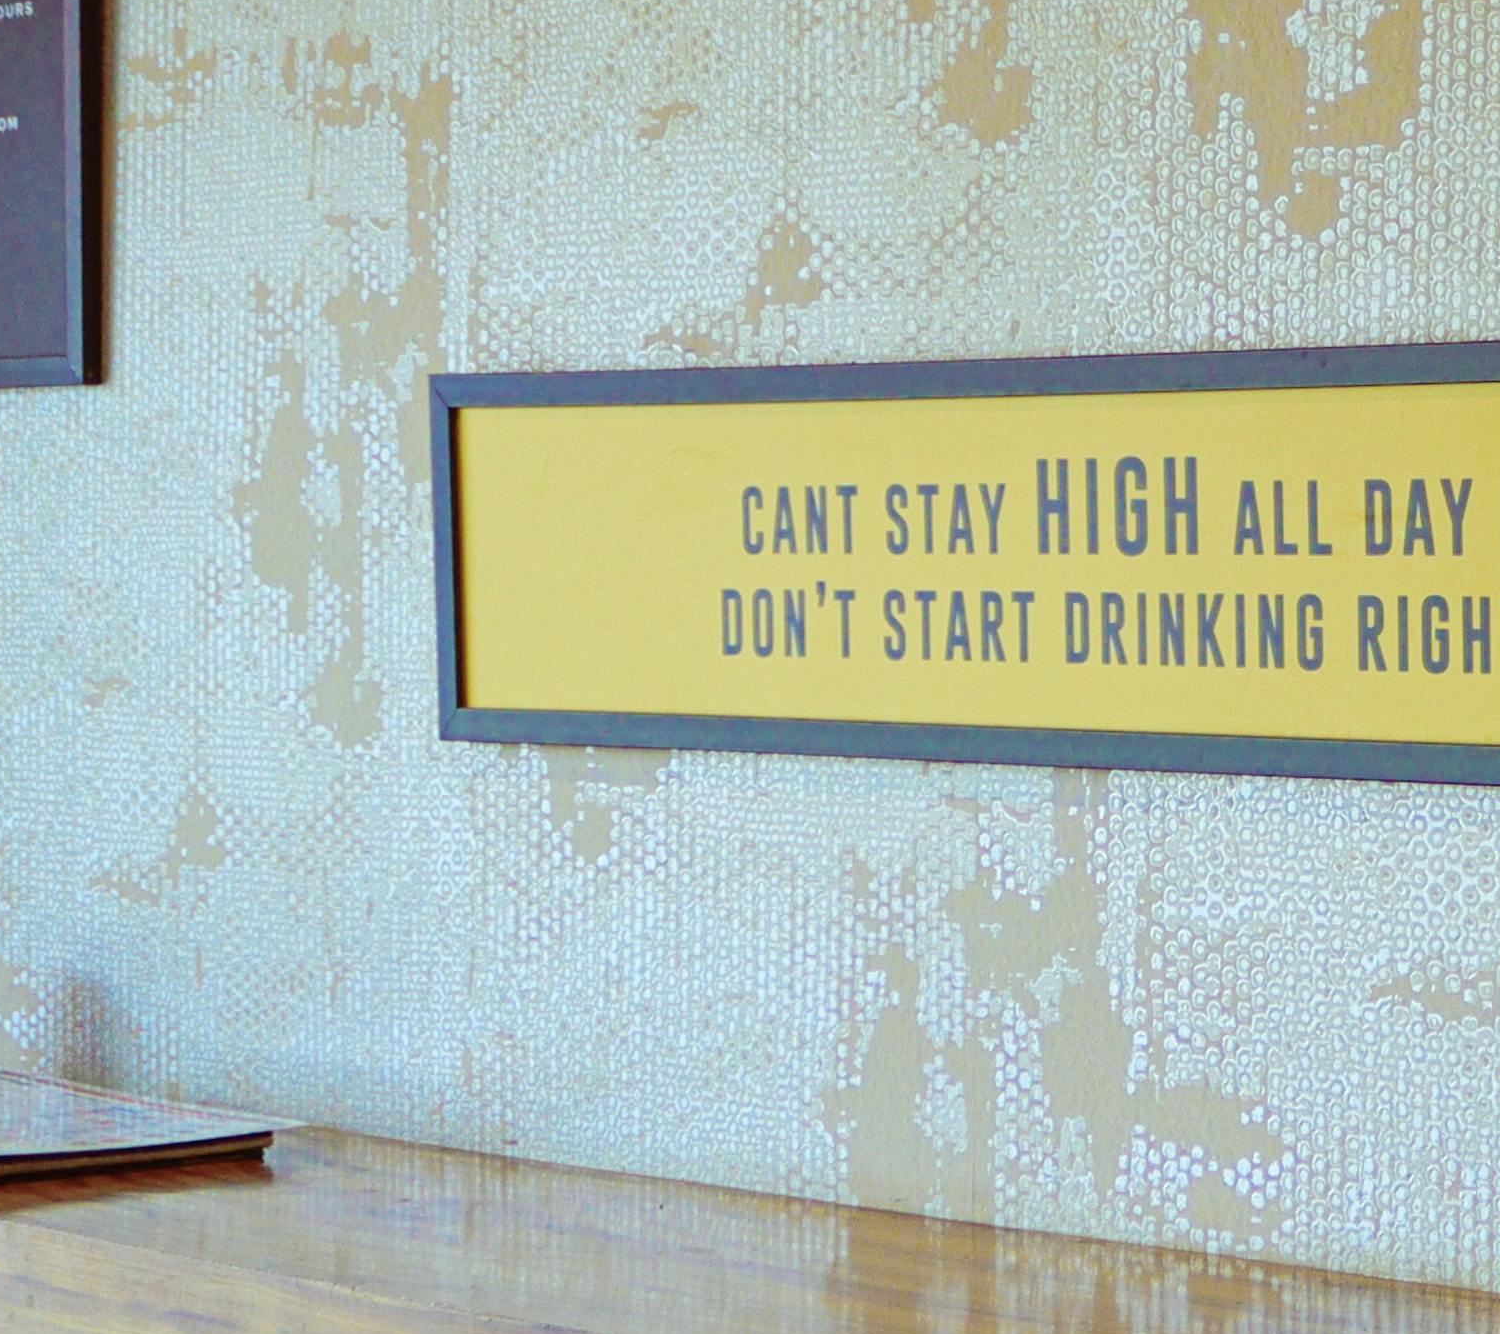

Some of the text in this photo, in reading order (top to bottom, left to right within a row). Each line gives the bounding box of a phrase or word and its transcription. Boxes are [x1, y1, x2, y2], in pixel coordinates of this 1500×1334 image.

[740, 483, 860, 557] CANT
[884, 481, 1008, 557] STAY
[1035, 454, 1200, 558] HIGH
[1232, 478, 1335, 558] ALL
[1362, 476, 1475, 558] DAY
[720, 579, 857, 660] DON'T
[881, 588, 1037, 664] START
[1063, 590, 1325, 673] DRINKING
